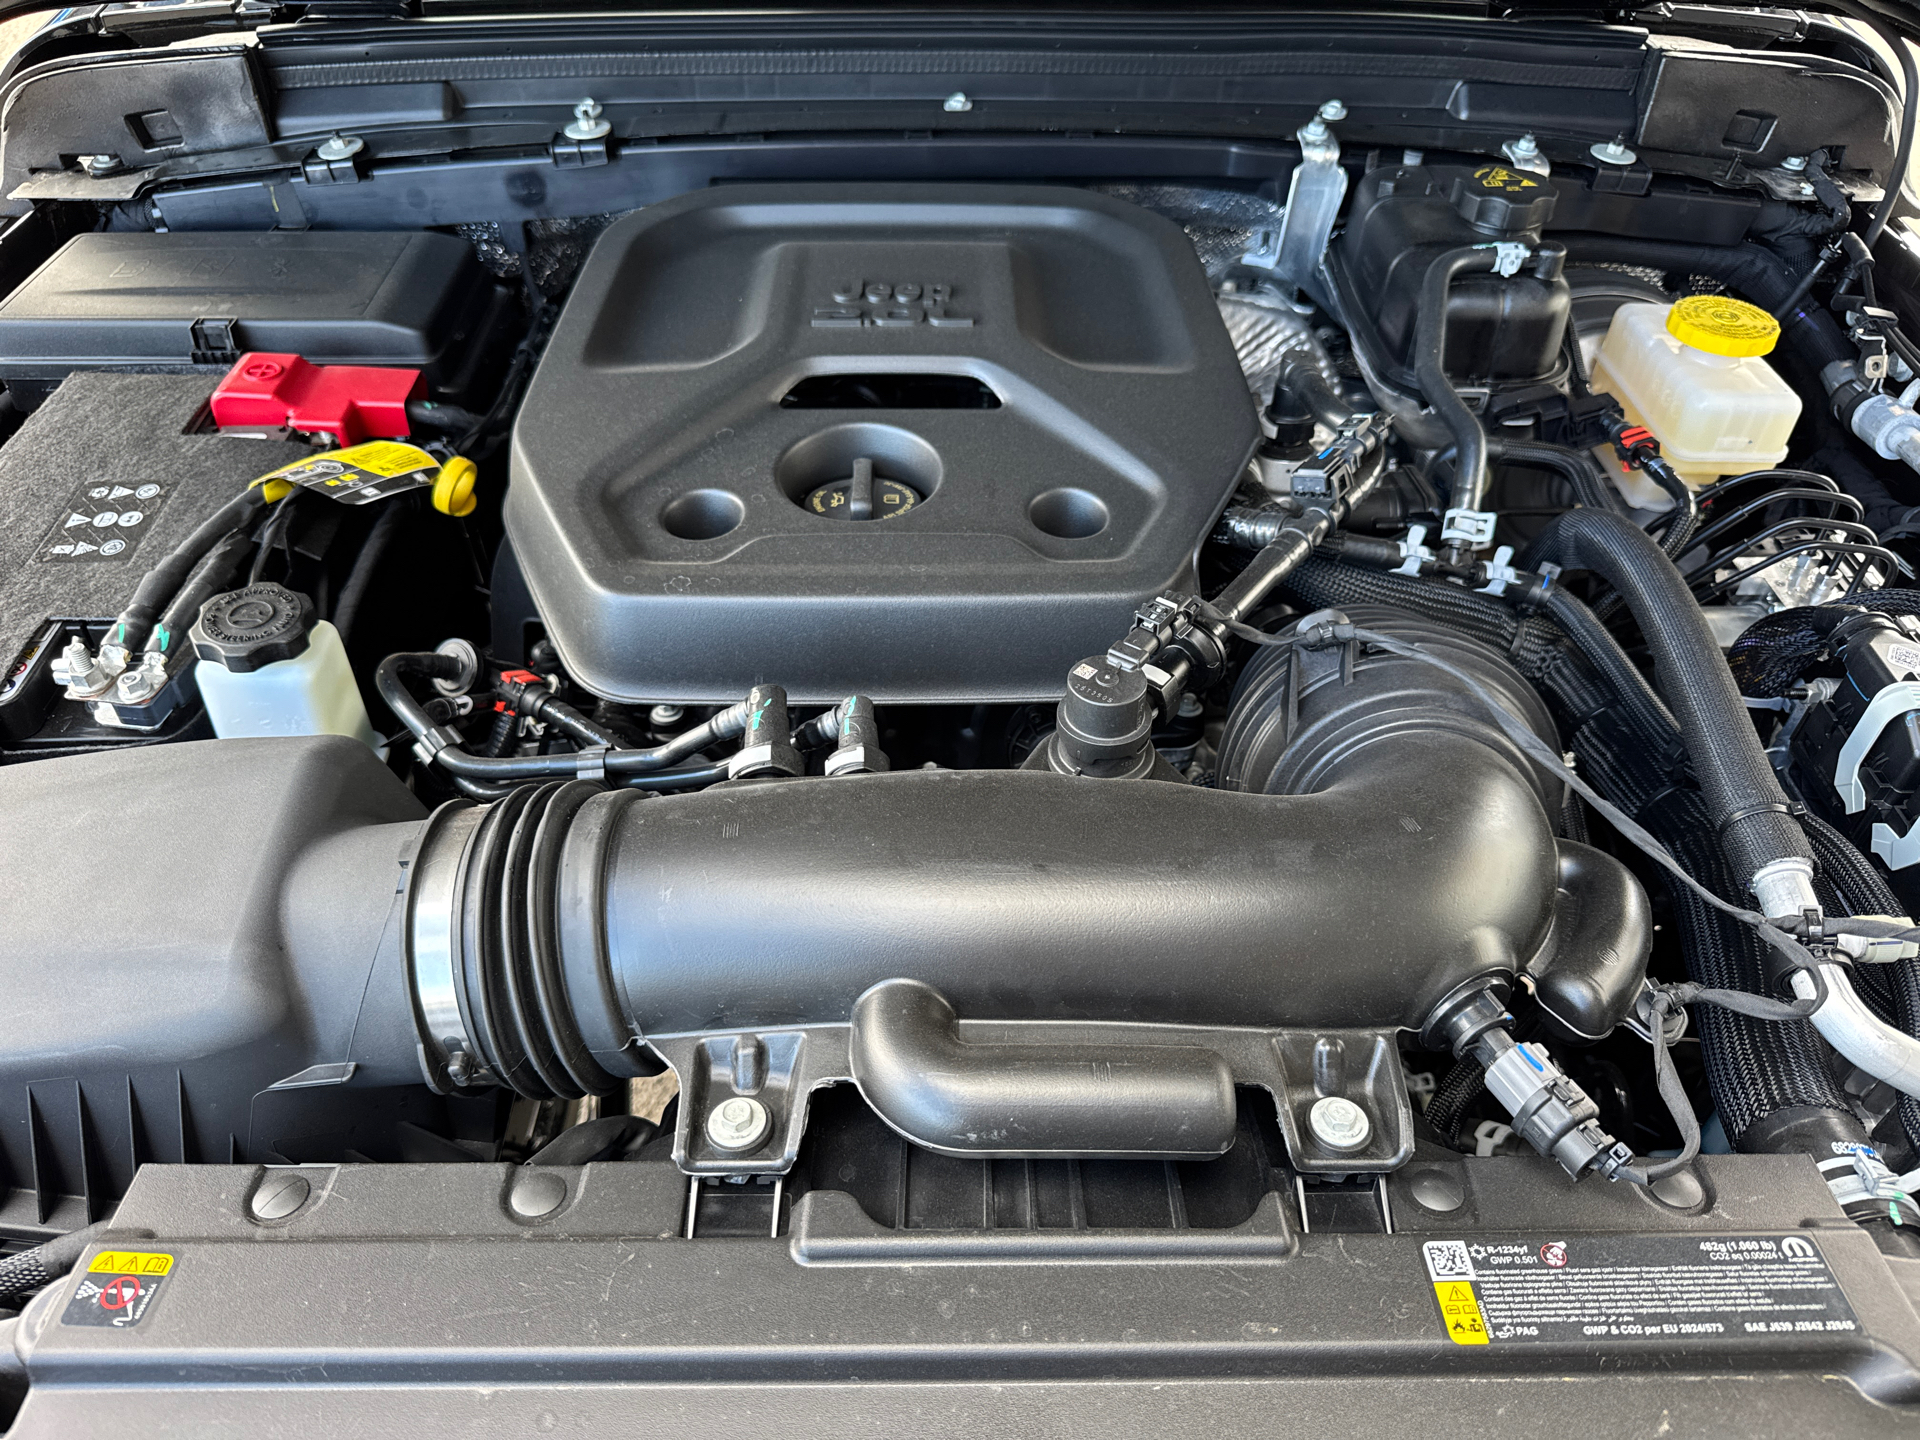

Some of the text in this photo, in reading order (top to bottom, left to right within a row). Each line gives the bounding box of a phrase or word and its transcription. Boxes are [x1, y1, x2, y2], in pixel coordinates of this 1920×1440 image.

[832, 279, 951, 308] Jeep
[1699, 1242, 1726, 1254] 482g
[1760, 1241, 1776, 1252] lb)
[1490, 1256, 1538, 1264] GWP 0.501
[1710, 1252, 1730, 1260] CO2
[1732, 1253, 1743, 1262] eq
[1744, 1252, 1778, 1260] 0.00024
[1516, 1326, 1538, 1336] PAG
[1583, 1323, 1724, 1336] GWP & CO2 per EU 2024/573
[1744, 1322, 1768, 1332] SAE
[1770, 1322, 1792, 1332] J639
